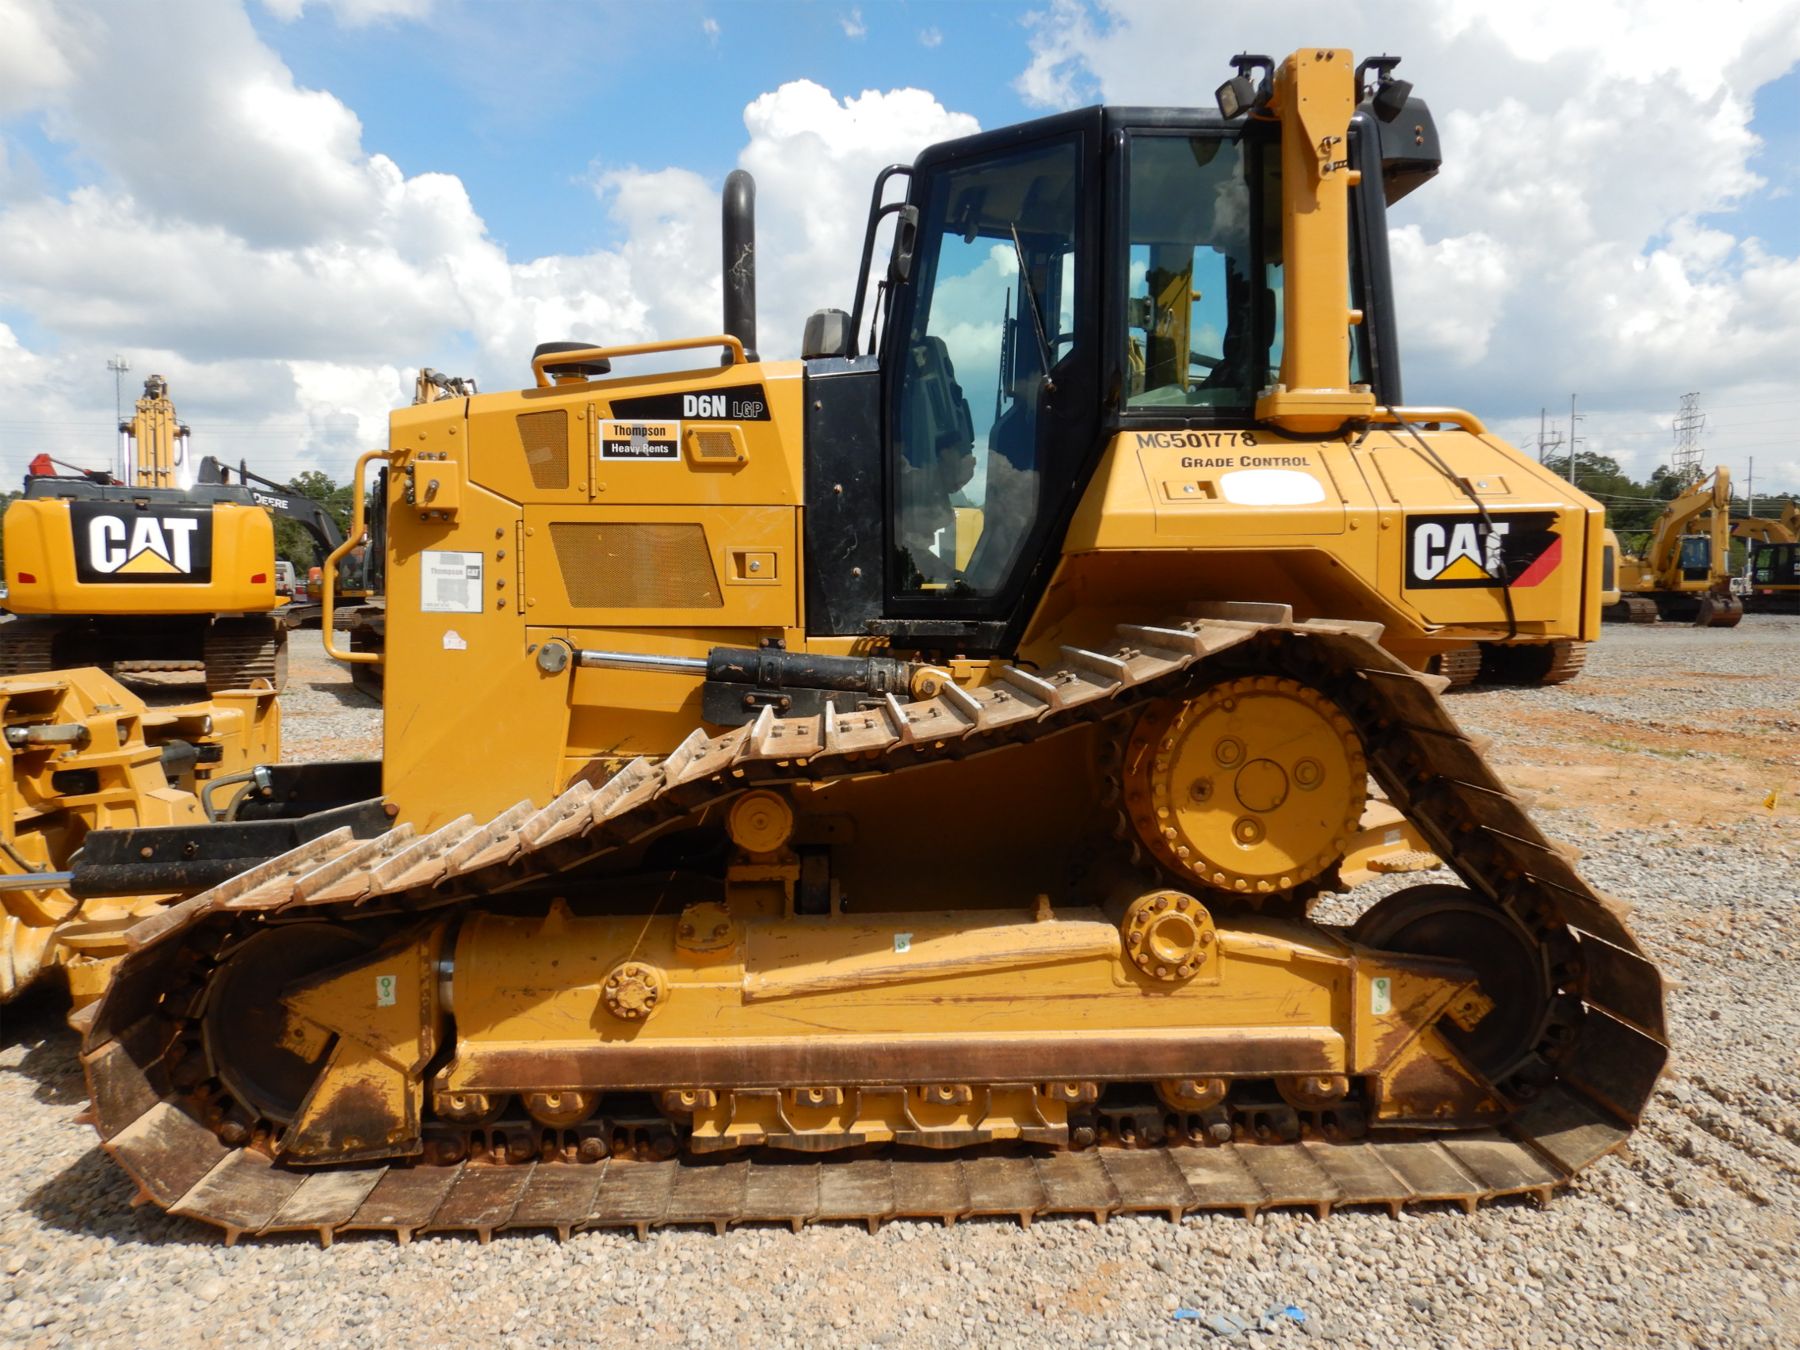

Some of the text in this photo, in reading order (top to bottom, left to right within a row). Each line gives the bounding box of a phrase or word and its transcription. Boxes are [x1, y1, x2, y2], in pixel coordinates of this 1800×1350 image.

[683, 394, 764, 418] D6N LGP
[613, 424, 667, 437] Thompson
[611, 442, 669, 455] Heavy Rents
[1135, 431, 1259, 449] MG501778
[1180, 455, 1311, 468] GRADE CONTROL
[252, 492, 289, 510] DEERE
[88, 514, 199, 574] CAT
[1413, 522, 1510, 581] CAT
